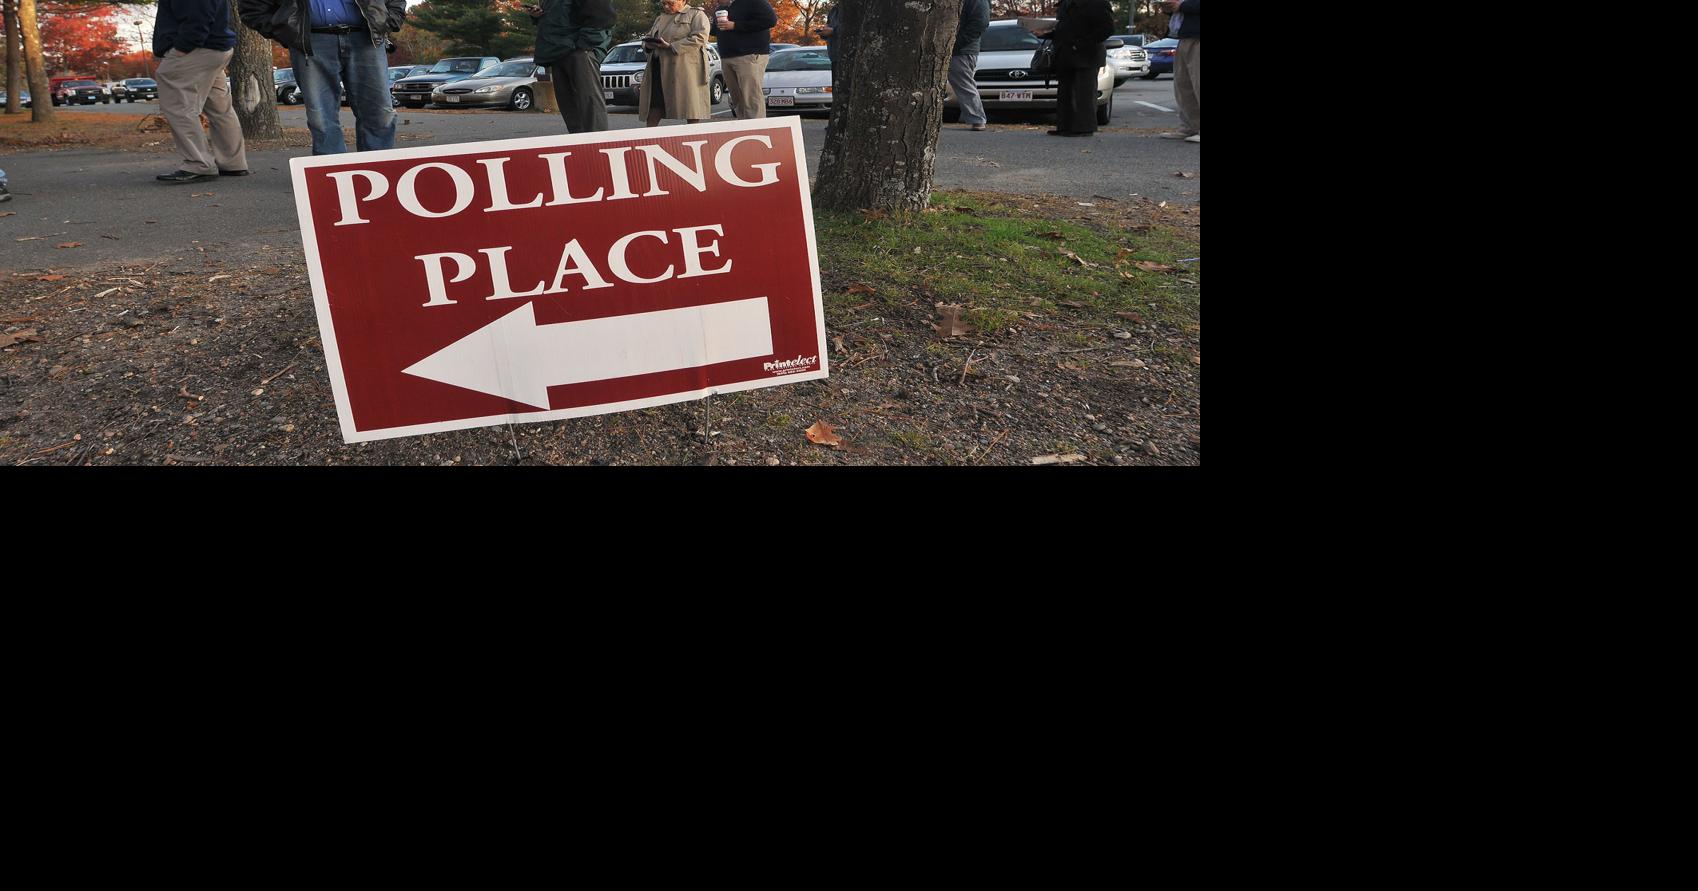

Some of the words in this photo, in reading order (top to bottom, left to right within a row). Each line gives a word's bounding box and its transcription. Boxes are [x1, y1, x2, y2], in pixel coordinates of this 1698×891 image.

[326, 134, 781, 227] POLLING
[414, 224, 733, 308] PLACE
[763, 354, 817, 371] Printelect
